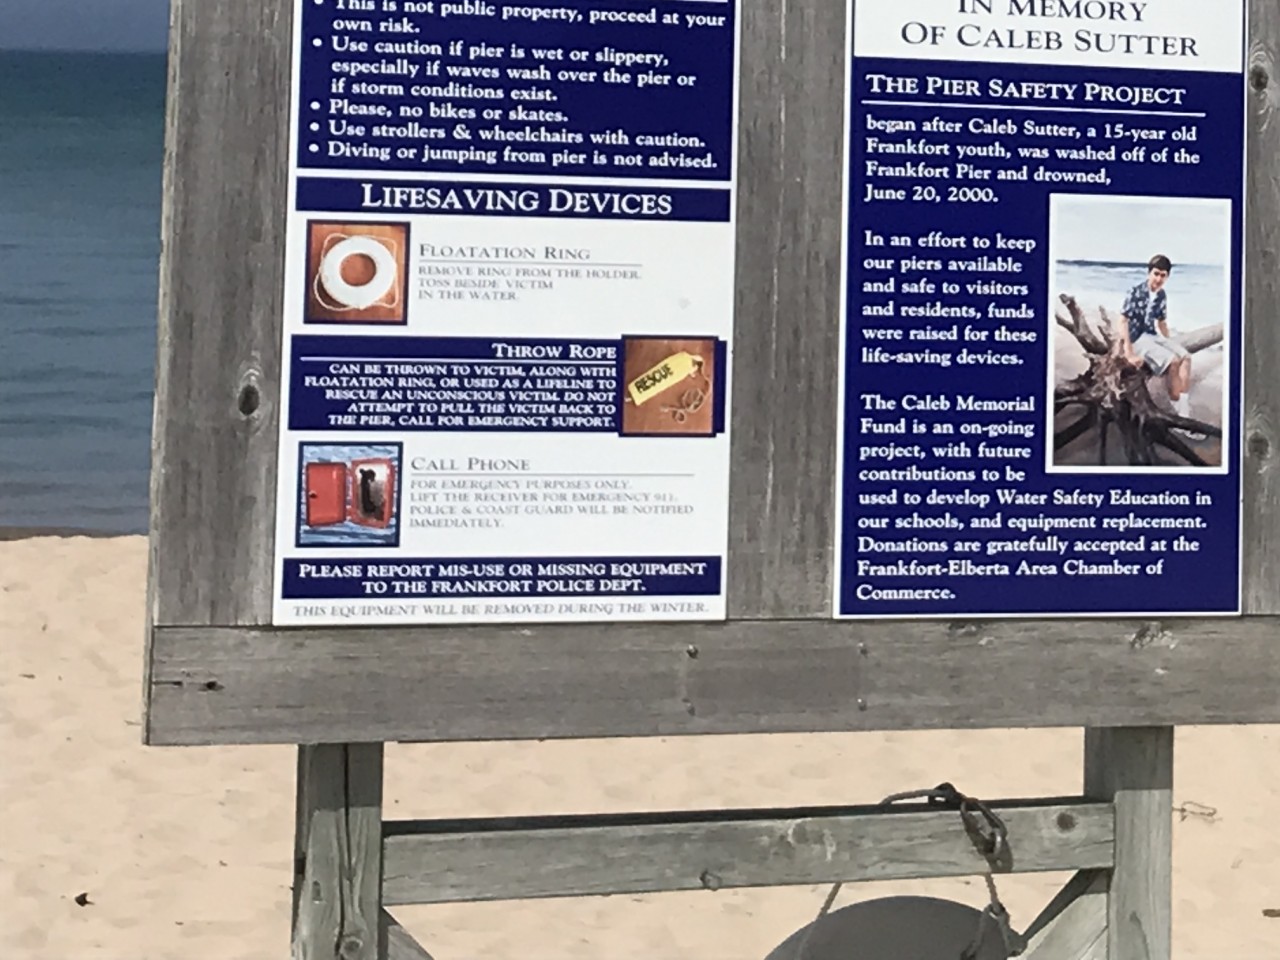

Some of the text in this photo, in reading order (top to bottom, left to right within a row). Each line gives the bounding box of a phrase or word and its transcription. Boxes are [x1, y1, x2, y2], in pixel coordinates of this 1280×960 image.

[403, 0, 434, 14] not
[501, 5, 583, 23] property,
[588, 7, 657, 24] proceed
[661, 12, 679, 25] at
[684, 14, 726, 28] your
[332, 17, 420, 33] own risk.
[900, 21, 1199, 57] OF CALEB SUTTER
[864, 73, 1186, 106] THE PIER SAFETY PROJECT
[328, 98, 569, 122] Please, no bikes or skates.
[328, 119, 706, 147] Use strollers & wheelchairs with caution.
[865, 113, 1197, 142] began after Caleb Sutter, a 15-year old
[865, 137, 1200, 164] Frankfort youth, was washed off of the
[865, 160, 1111, 185] Frankfort Pier and drowned,
[360, 182, 672, 215] LIFESAVING DEVICES
[863, 183, 999, 203] June 20, 2000.
[419, 243, 590, 261] FLOATATION RING
[490, 342, 617, 359] THROW ROPE
[328, 363, 360, 374] CAN
[363, 363, 382, 375] BE
[383, 363, 447, 375] THROWN
[450, 364, 471, 375] TO
[528, 365, 577, 377] ALONG
[579, 366, 617, 377] WITH
[634, 363, 674, 394] RESCUE
[410, 456, 528, 471] CALL PHONE
[858, 489, 1212, 508] used to develop Water Safety Education in
[857, 512, 1207, 532] our schools, and equipment replacement.
[857, 534, 1200, 555] Donations are gratefully accepted at the
[298, 562, 707, 578] PLEASE REPORT MIS-USE OR MISSING EQUIPMENT
[856, 558, 1164, 576] Frankfort-Elberta Area Chamber of
[361, 578, 646, 594] TO THE FRANKFORT POLICE DEPT.
[856, 583, 956, 600] Commerce.
[293, 605, 326, 617] THIS
[330, 604, 417, 618] EQUIPMENT
[422, 603, 458, 615] WILL
[460, 603, 478, 615] BE
[483, 603, 555, 615] REMOVED
[557, 602, 613, 615] DURING
[618, 602, 645, 613] THE
